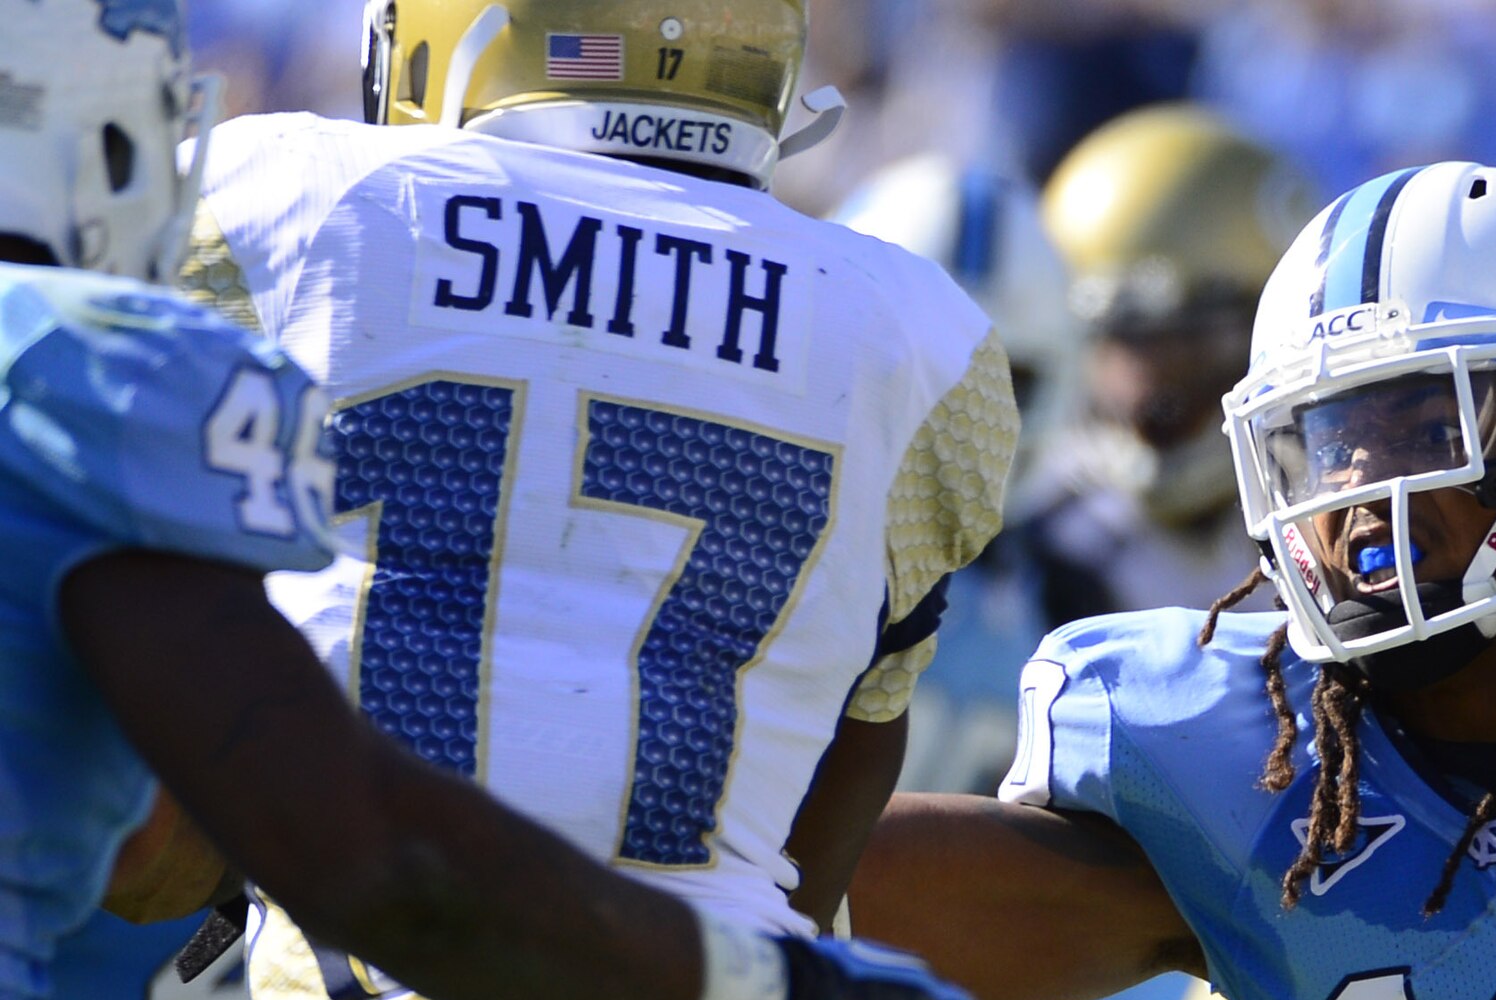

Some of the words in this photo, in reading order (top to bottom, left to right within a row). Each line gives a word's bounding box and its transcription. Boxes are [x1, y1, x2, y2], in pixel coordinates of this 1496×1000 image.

[656, 47, 684, 80] 17
[592, 110, 731, 154] JACKETS
[434, 195, 787, 373] SMITH
[1307, 309, 1367, 344] ACC
[1285, 527, 1321, 596] Riddell
[330, 370, 843, 869] 17
